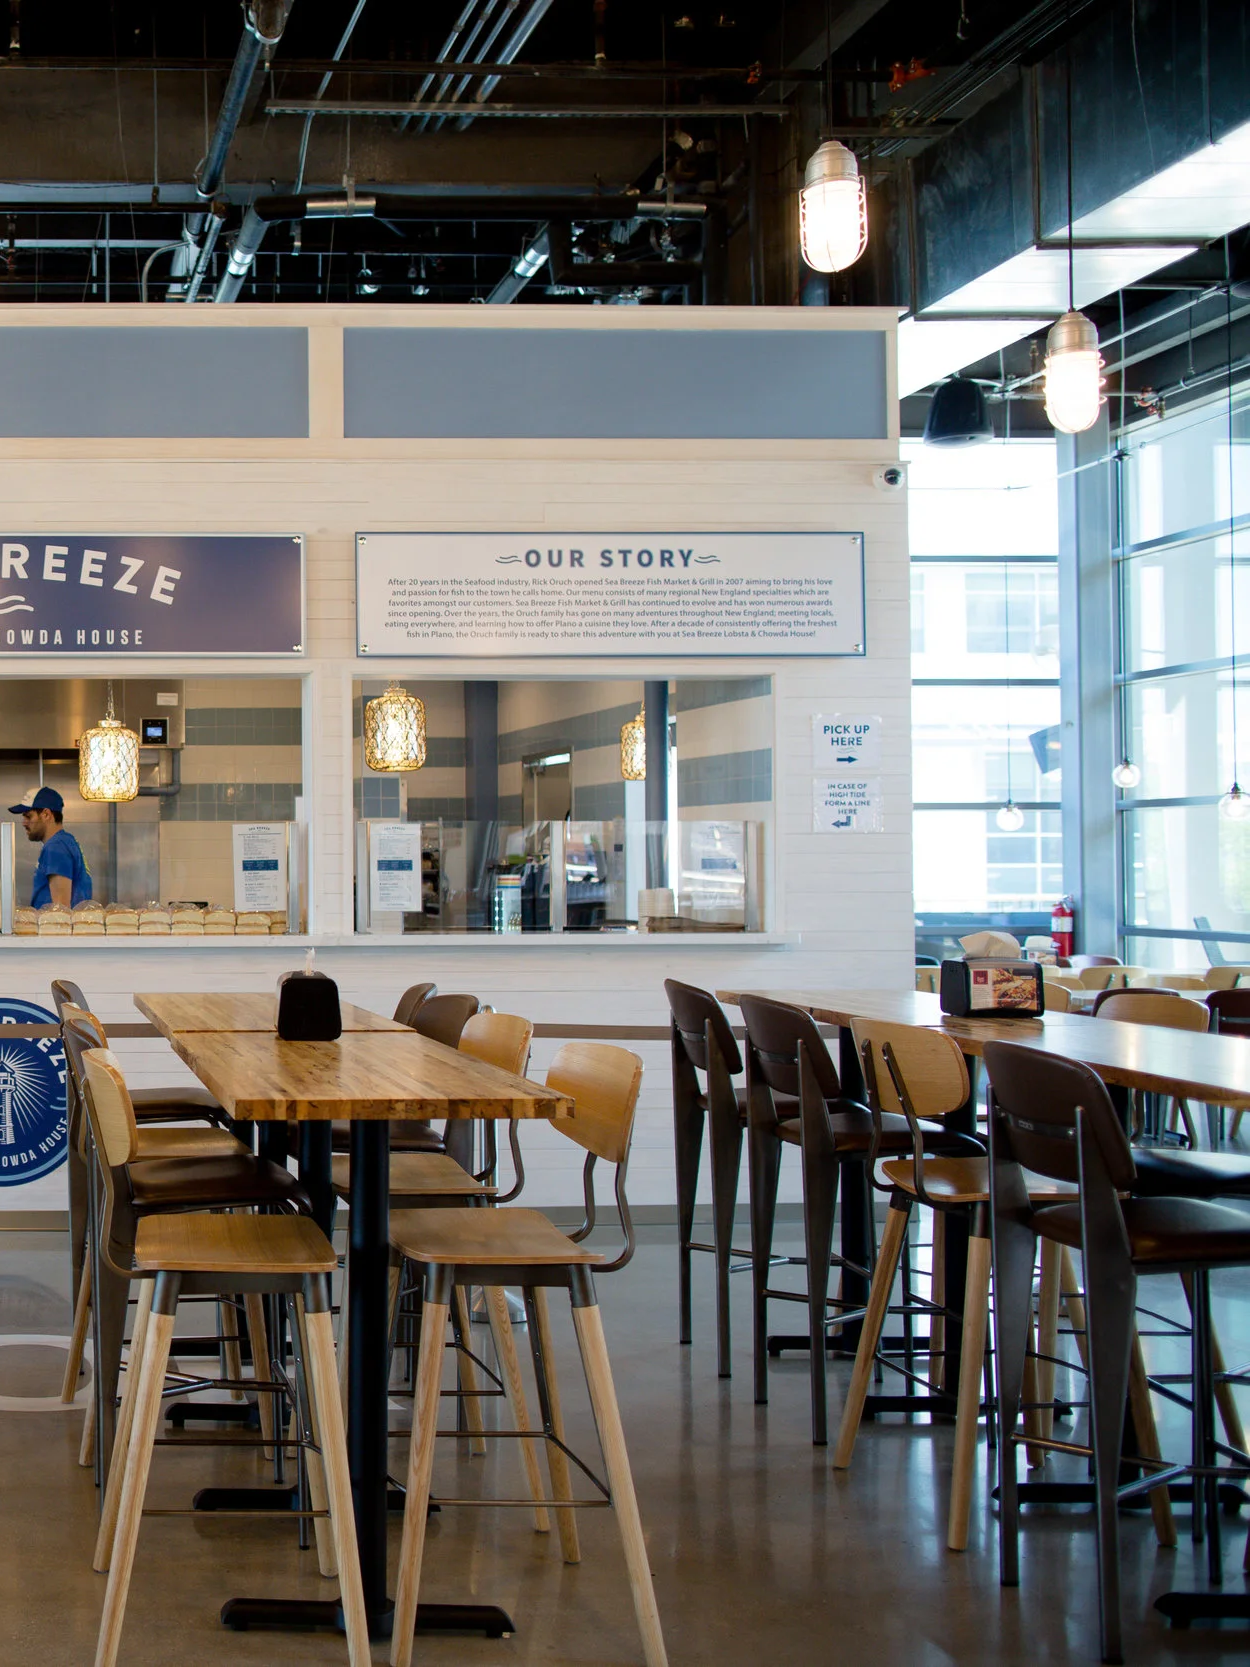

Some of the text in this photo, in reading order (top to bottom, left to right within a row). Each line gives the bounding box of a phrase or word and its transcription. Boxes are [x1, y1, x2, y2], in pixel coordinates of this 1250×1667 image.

[526, 550, 694, 567] OUR STORY
[497, 578, 530, 588] industry,
[574, 578, 603, 588] opened
[746, 578, 771, 588] aiming
[782, 578, 803, 588] bring
[408, 588, 437, 598] passion
[669, 588, 700, 598] regional
[720, 588, 751, 598] England
[752, 588, 792, 598] specialties
[423, 599, 457, 608] amongst
[408, 609, 442, 619] opening.
[540, 609, 564, 619] family
[636, 609, 678, 617] adventures
[679, 609, 723, 619] throughout
[743, 609, 776, 619] England;
[777, 609, 809, 619] meeting
[810, 609, 832, 618] locals,
[385, 620, 409, 629] eating
[410, 620, 457, 629] everywhere,
[475, 620, 506, 629] learning
[612, 620, 629, 629] they
[715, 620, 760, 629] consistently
[762, 620, 792, 629] offering
[78, 630, 142, 644] HOUSE
[824, 725, 870, 734] PICK UP
[831, 737, 862, 745] HERE
[39, 1118, 68, 1153] HOUSE
